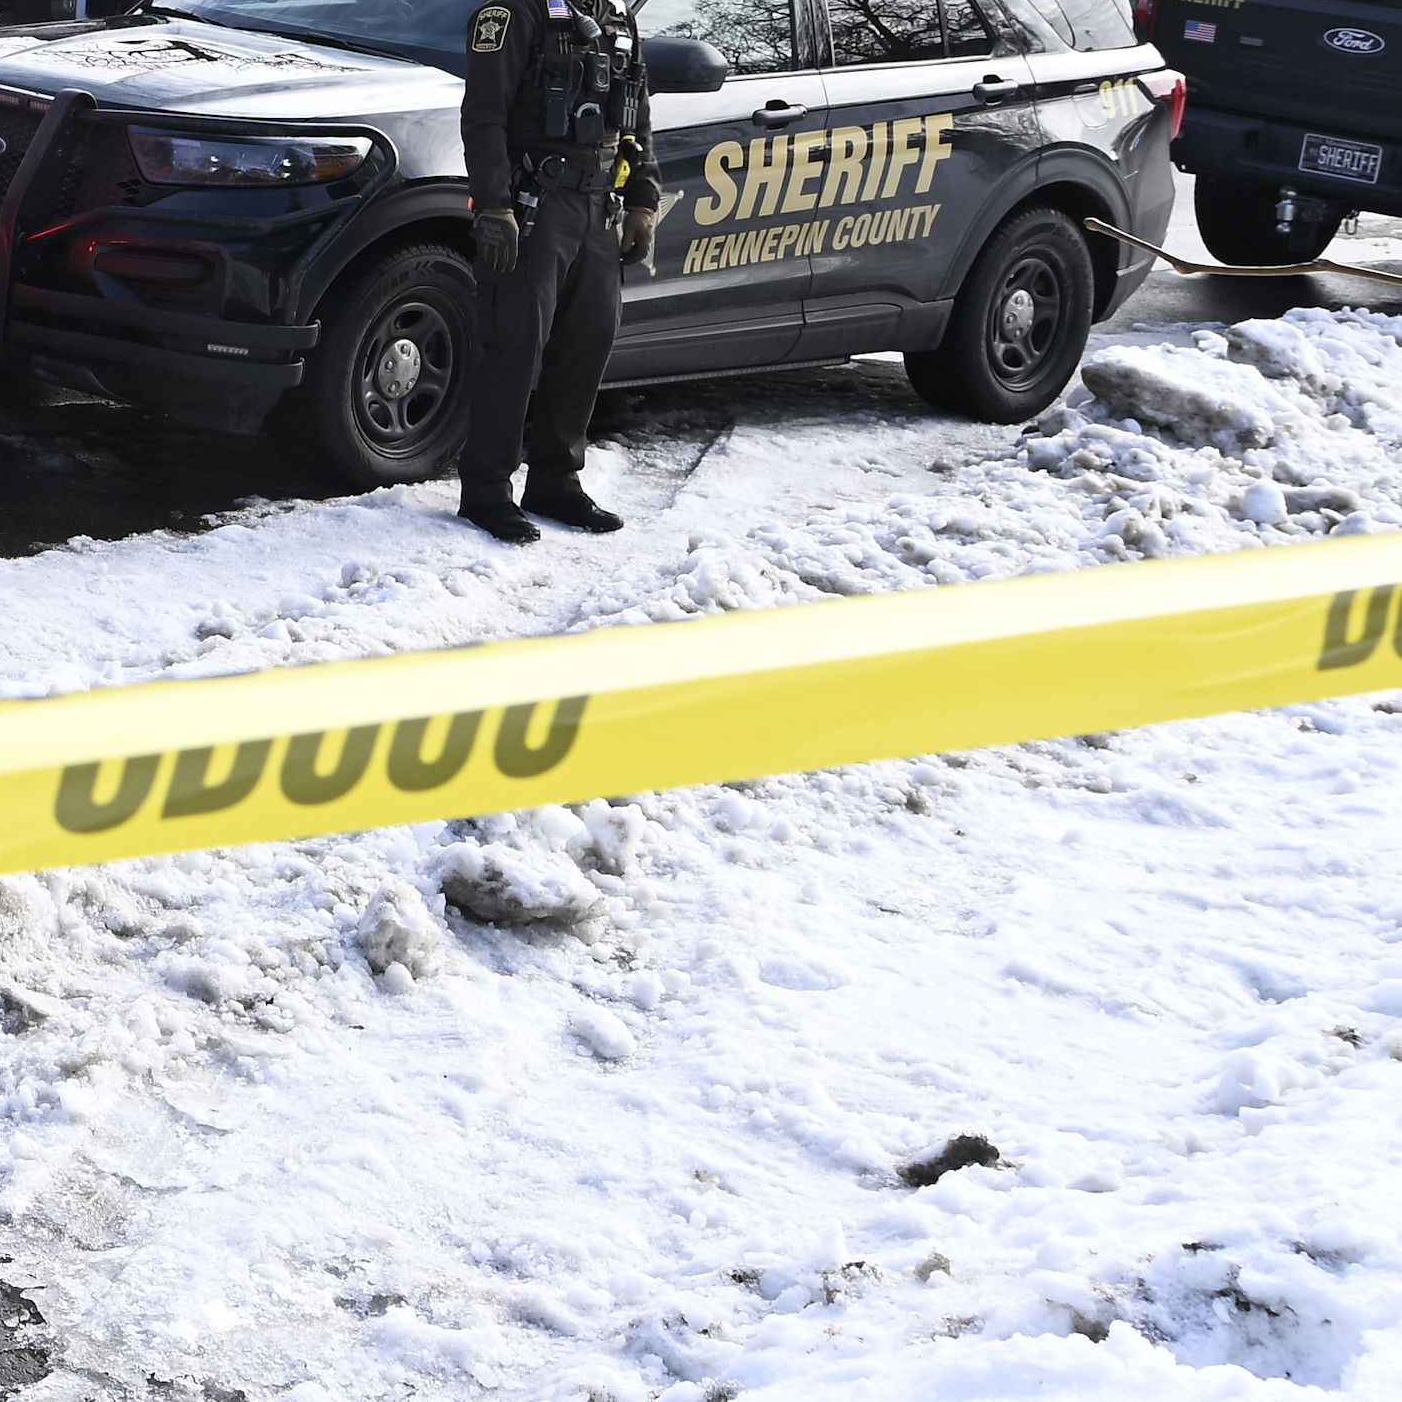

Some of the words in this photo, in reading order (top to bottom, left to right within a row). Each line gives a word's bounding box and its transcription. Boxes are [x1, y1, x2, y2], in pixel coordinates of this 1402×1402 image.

[1332, 30, 1375, 51] Ford
[1099, 77, 1138, 119] 911
[694, 113, 954, 226] SHERIFF
[1318, 145, 1379, 174] SHERIFF
[683, 220, 830, 274] HENNEPIN
[832, 203, 942, 250] COUNTY
